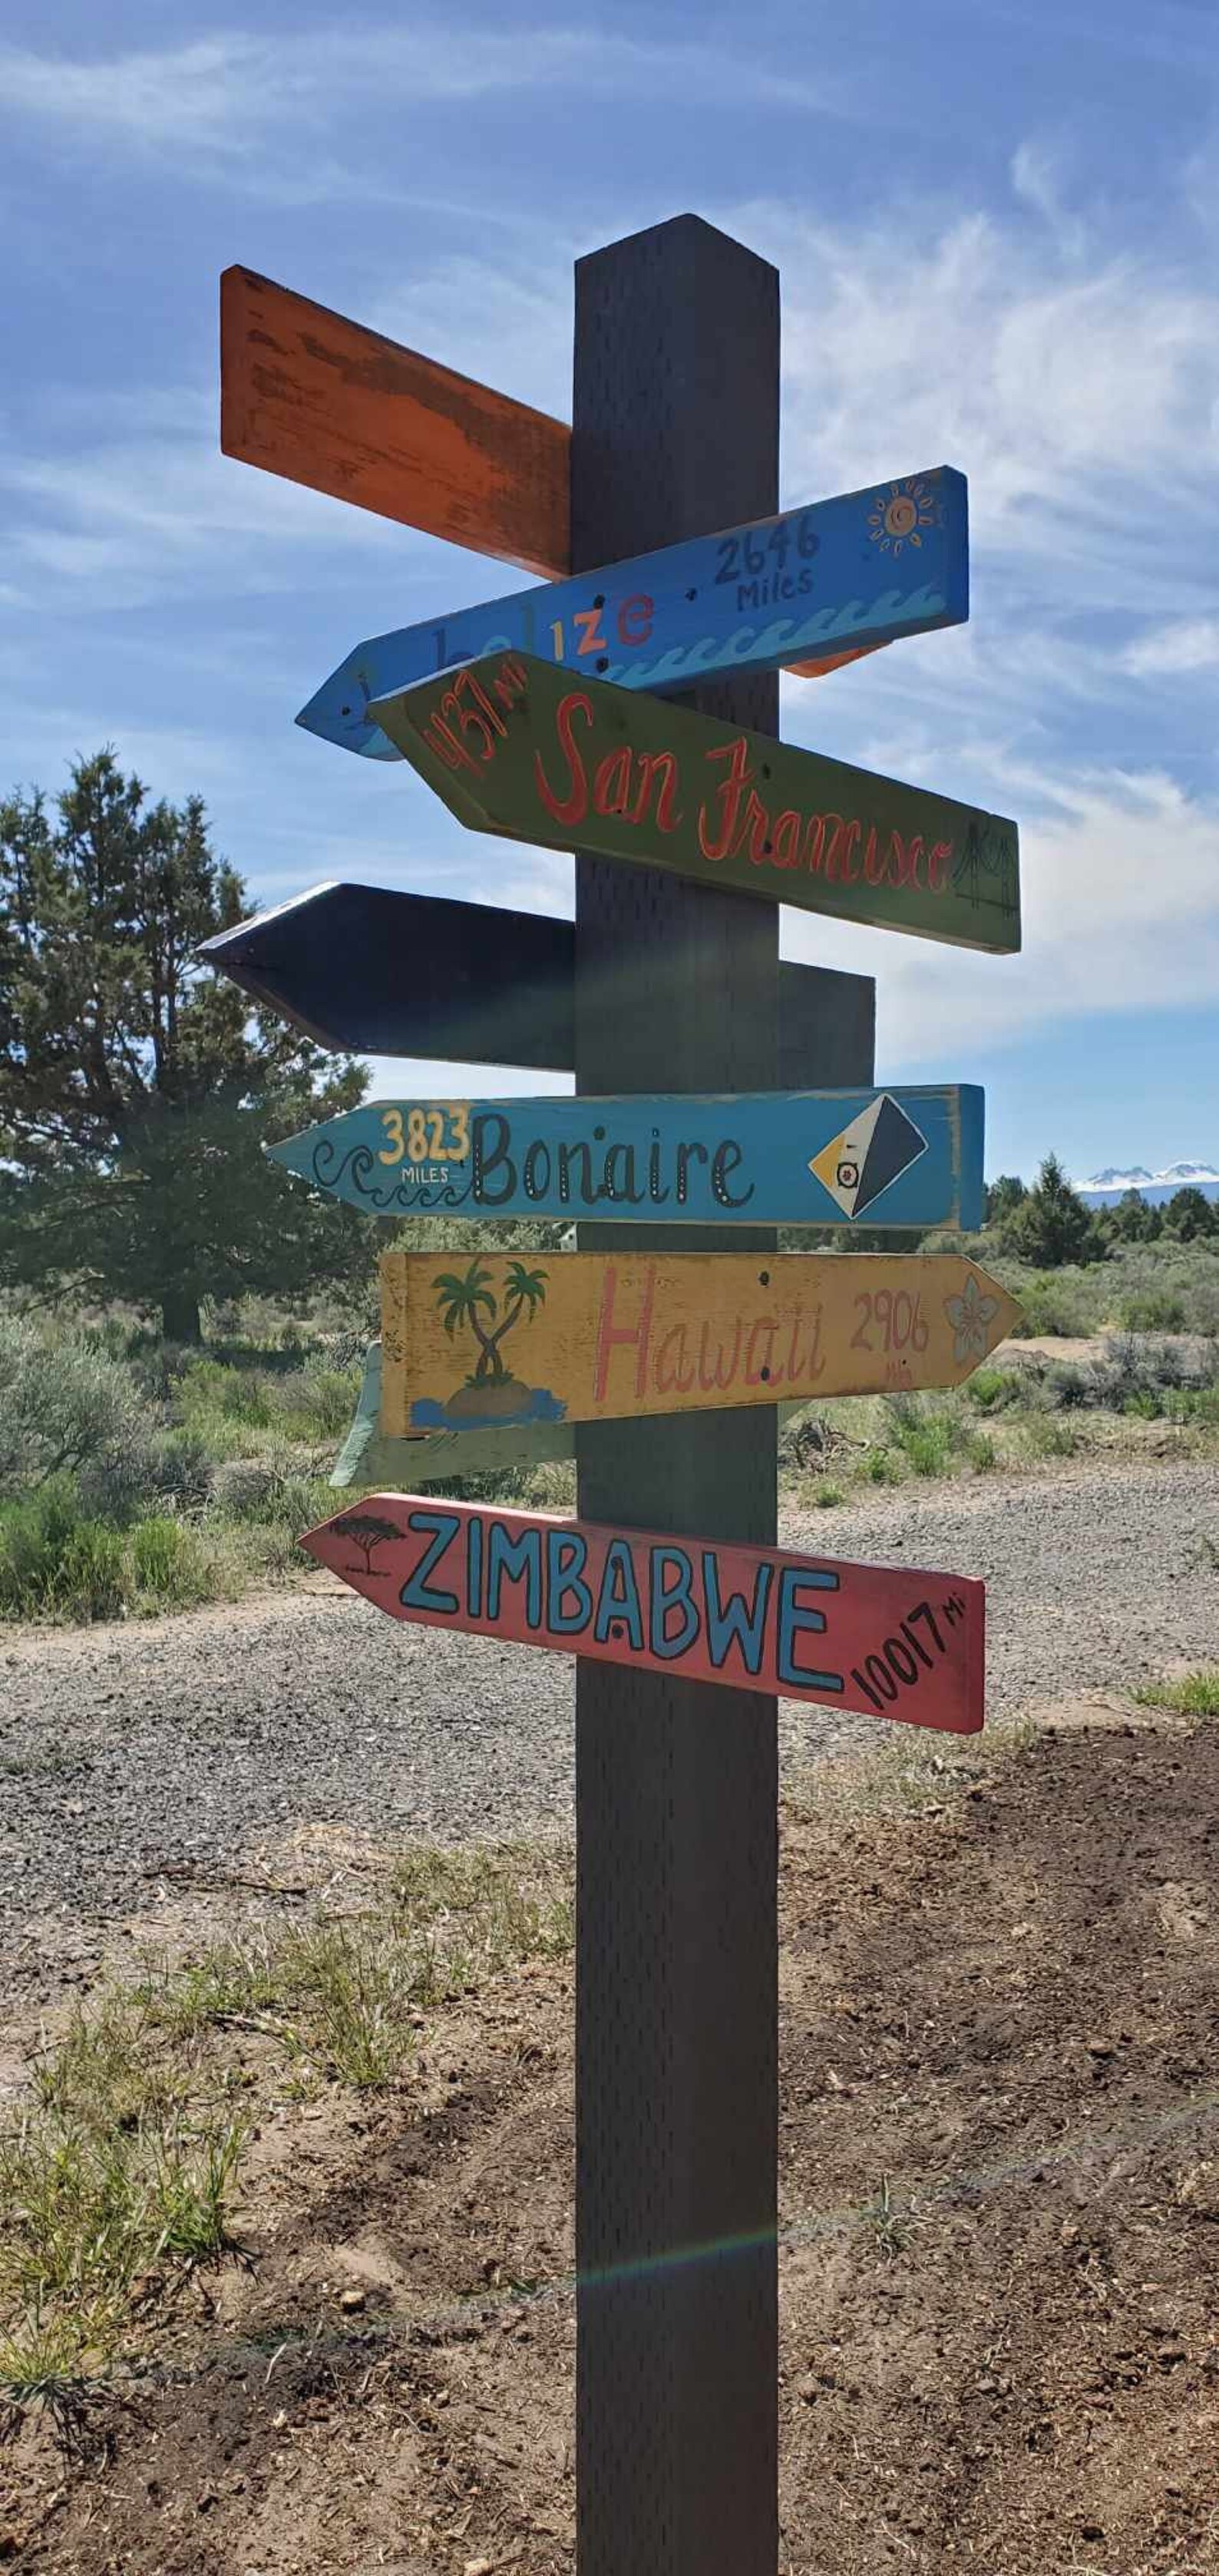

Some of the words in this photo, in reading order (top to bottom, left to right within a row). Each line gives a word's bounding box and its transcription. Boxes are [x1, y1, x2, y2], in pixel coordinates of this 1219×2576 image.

[715, 514, 820, 585] 2646
[737, 569, 811, 612] Miles
[423, 670, 507, 778] 437
[534, 692, 684, 833] San
[699, 736, 953, 894] Francisco
[379, 1105, 470, 1165] 3823
[401, 1166, 449, 1184] MILES
[471, 1114, 755, 1208] Bonaire
[593, 1265, 826, 1402] Hawaii
[850, 1289, 929, 1352] 2906
[399, 1511, 844, 1693] ZIMBABWE
[851, 1601, 946, 1710] 10017
[942, 1592, 966, 1627] Mi
